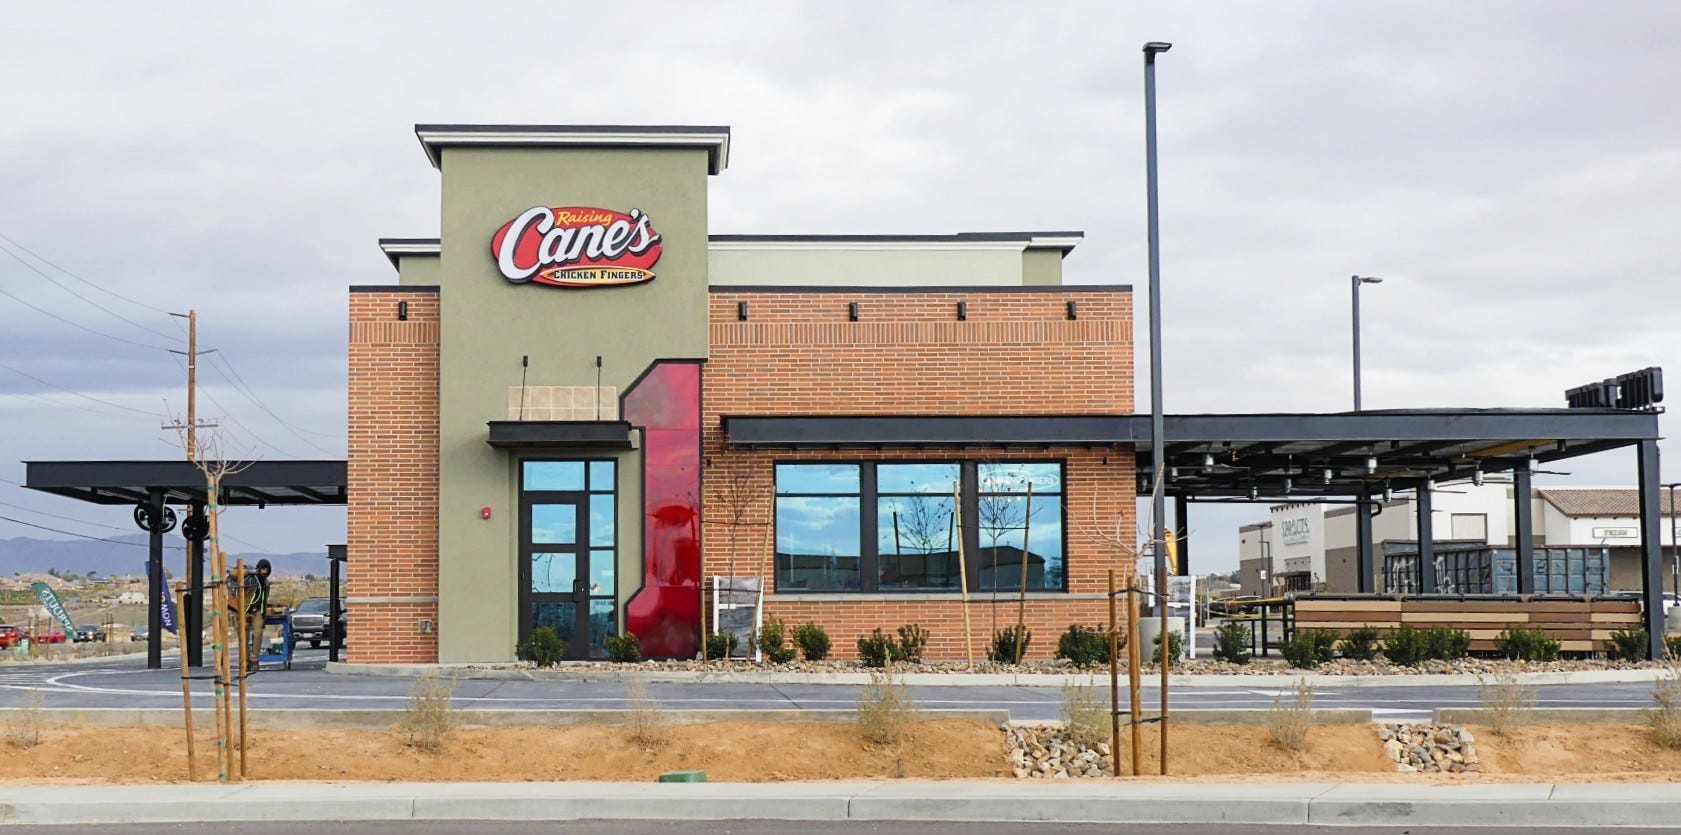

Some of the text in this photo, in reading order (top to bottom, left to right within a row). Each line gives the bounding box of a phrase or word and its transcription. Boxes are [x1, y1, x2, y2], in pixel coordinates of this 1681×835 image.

[556, 210, 613, 226] Raising
[499, 206, 660, 280] Cane's
[553, 270, 644, 280] CHICKEN FINGERS
[161, 603, 173, 627] NOW
